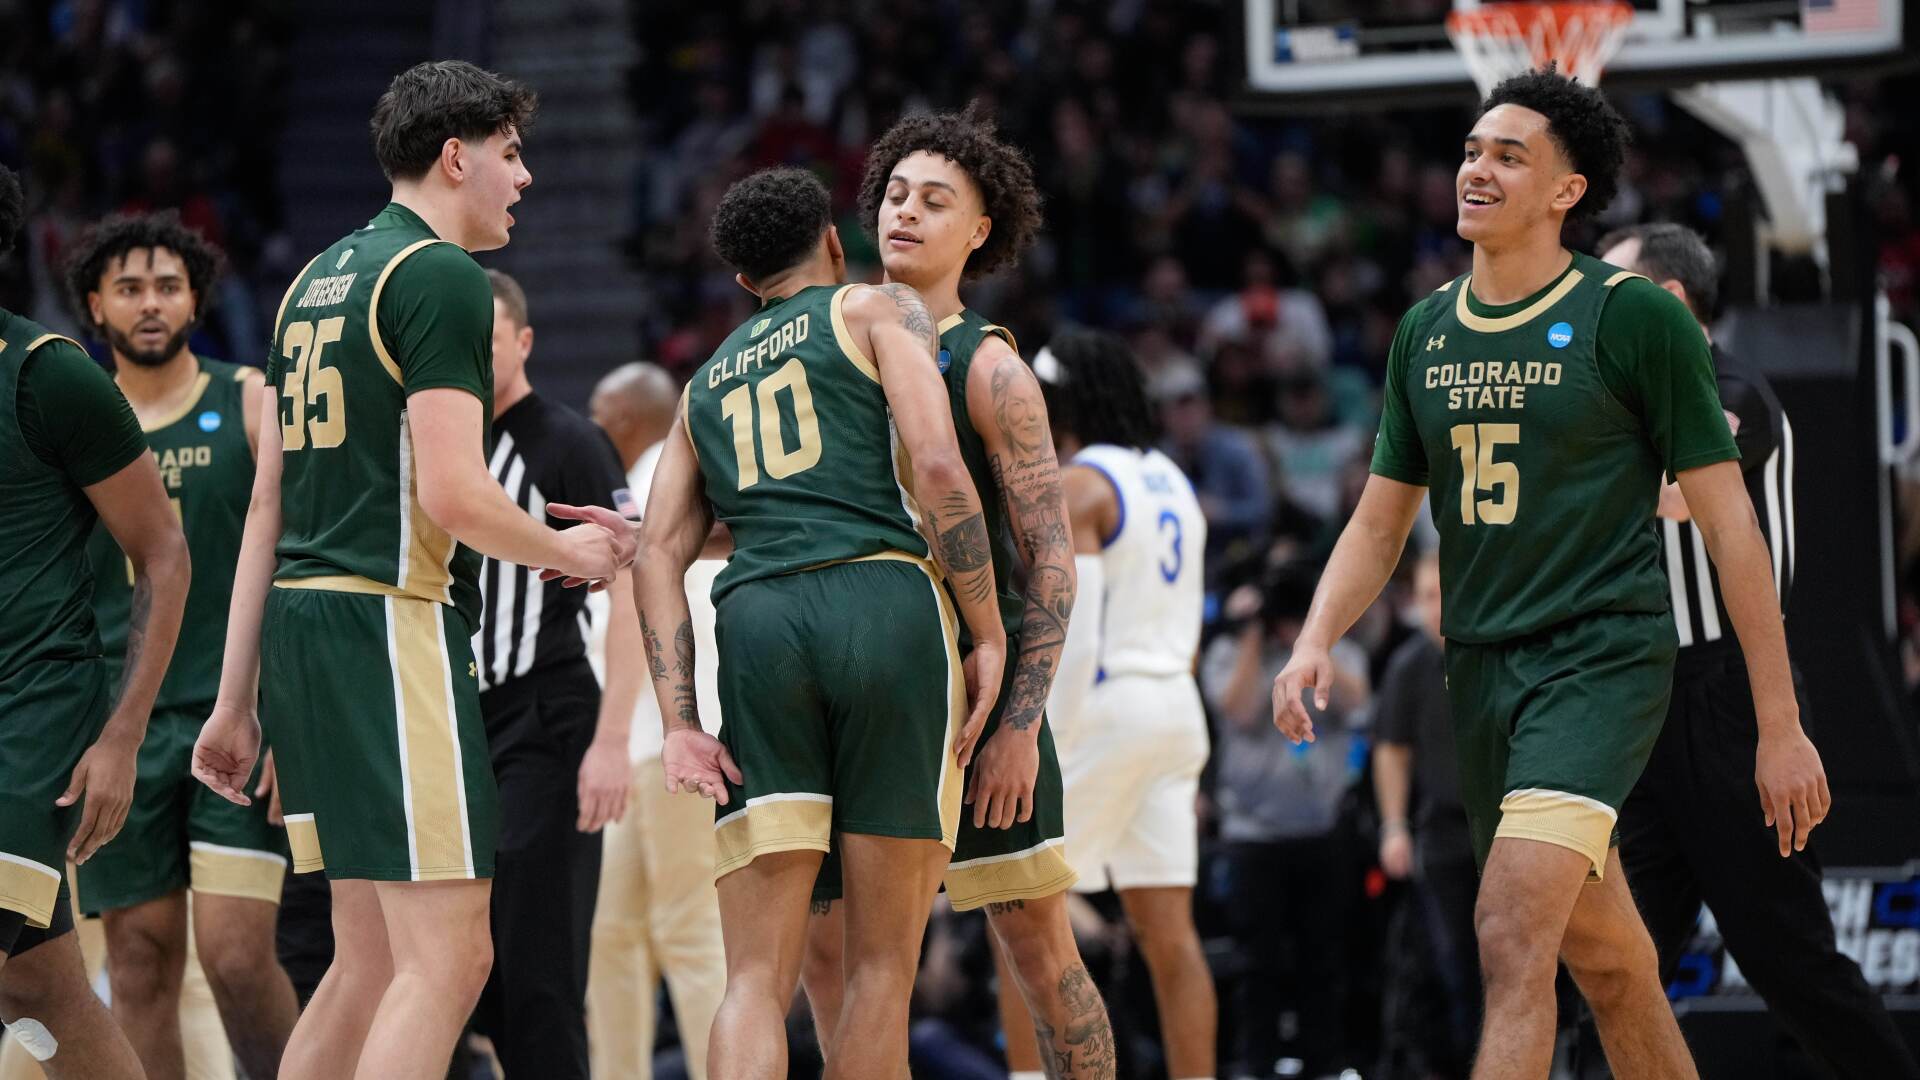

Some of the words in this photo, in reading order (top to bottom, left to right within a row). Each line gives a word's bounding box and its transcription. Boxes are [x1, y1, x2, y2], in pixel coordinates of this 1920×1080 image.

[296, 273, 357, 308] JORGENSEN
[282, 316, 346, 451] 35
[708, 313, 809, 389] CLIFFORD
[1425, 361, 1562, 389] COLORADO
[721, 357, 823, 491] 10
[1448, 386, 1525, 410] STATE
[1450, 423, 1520, 525] 15
[1158, 510, 1181, 583] 3
